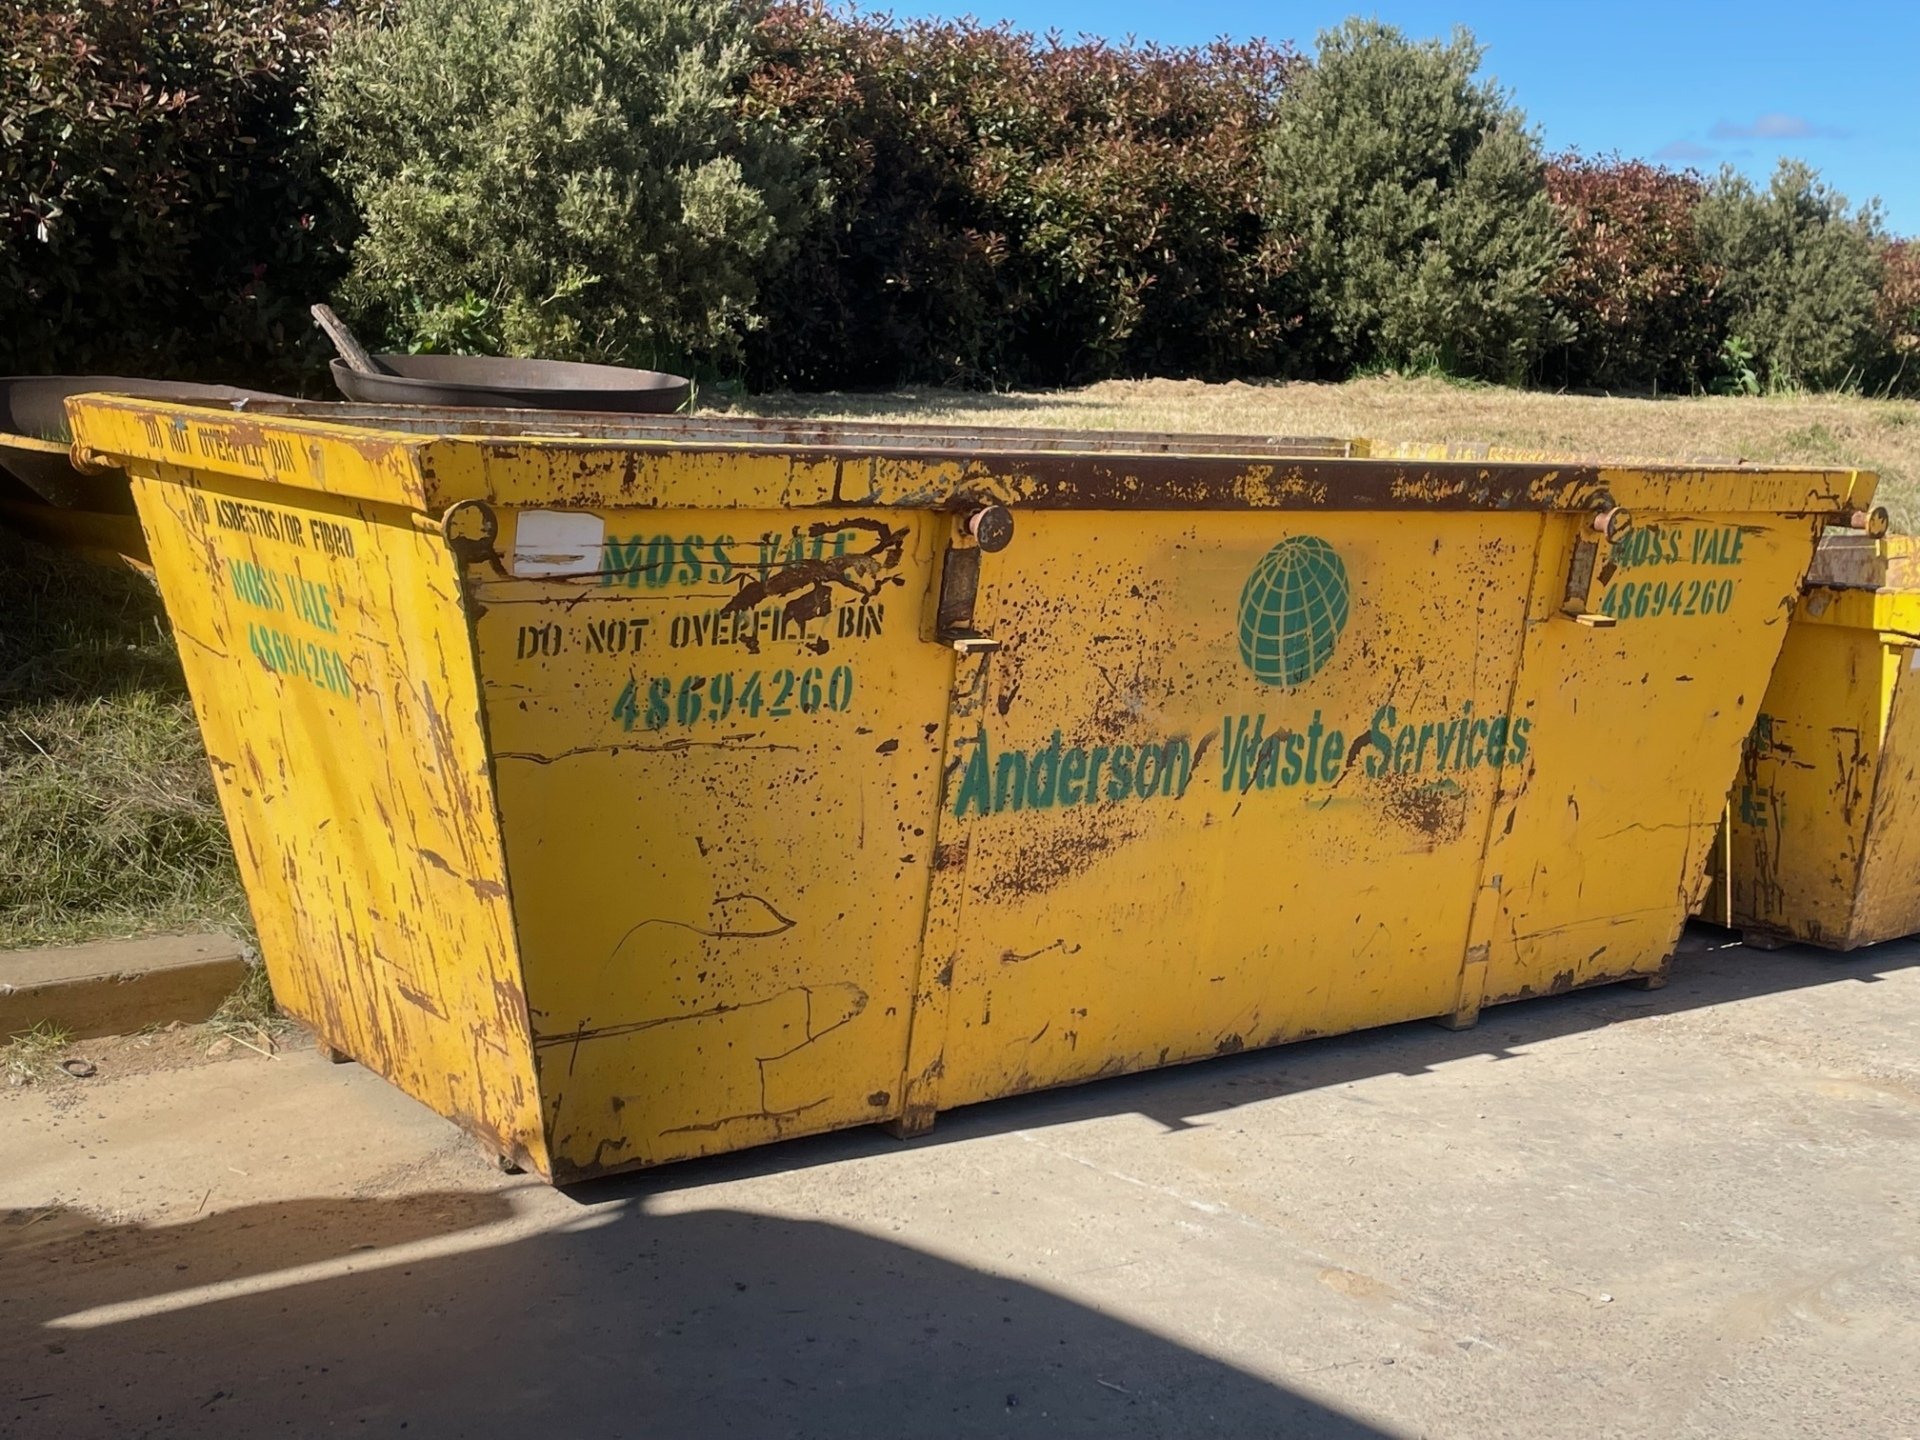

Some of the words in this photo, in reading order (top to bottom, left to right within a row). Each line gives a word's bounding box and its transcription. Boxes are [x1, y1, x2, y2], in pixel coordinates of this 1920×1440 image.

[145, 420, 163, 449] DO
[166, 421, 193, 455] NOT
[268, 437, 297, 473] BIN
[308, 518, 355, 559] FIBRO
[600, 533, 737, 589] MOSS
[1691, 527, 1744, 565] VALE
[227, 556, 285, 613] MOSS
[284, 573, 337, 634] VALE
[1602, 578, 1734, 620] 48694260
[517, 622, 562, 659] DO
[585, 618, 650, 654] NOT
[837, 602, 884, 639] BIN
[248, 622, 351, 700] 48694260
[612, 665, 854, 733] 48694260
[952, 728, 1192, 818] Anderson
[1221, 709, 1346, 793] Waste
[1364, 699, 1533, 780] Services
